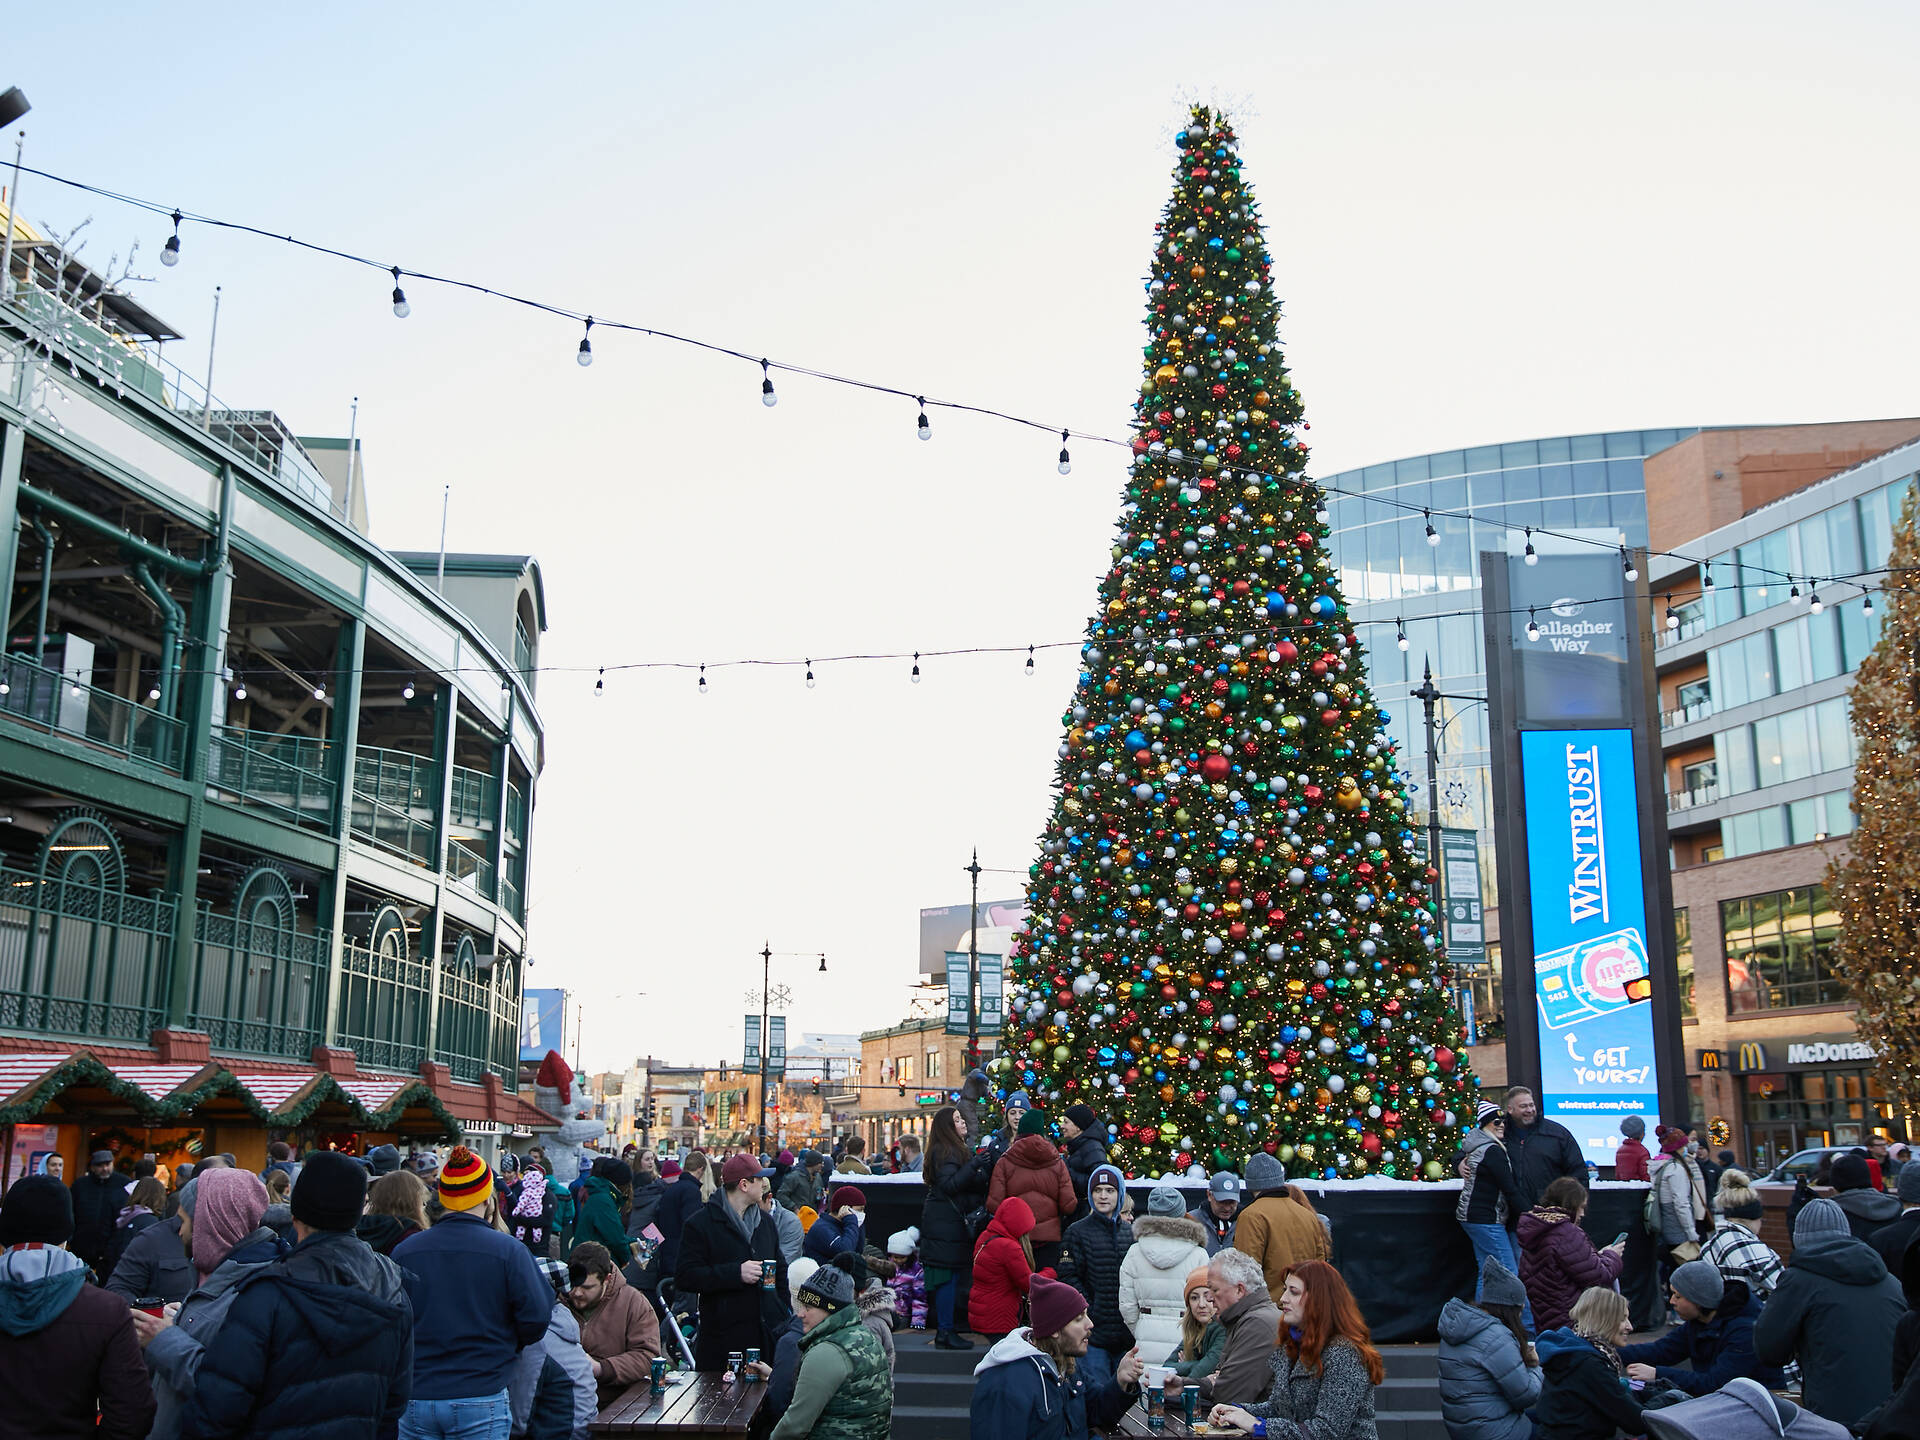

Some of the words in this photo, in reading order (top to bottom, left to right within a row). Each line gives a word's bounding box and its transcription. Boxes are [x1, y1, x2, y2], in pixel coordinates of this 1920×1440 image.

[1549, 637, 1590, 655] Way
[1566, 743, 1602, 925] WINTRUST
[1593, 1046, 1630, 1068] GET
[1573, 1066, 1650, 1085] YOURS!
[1557, 1100, 1645, 1110] wintrust.com/cubs
